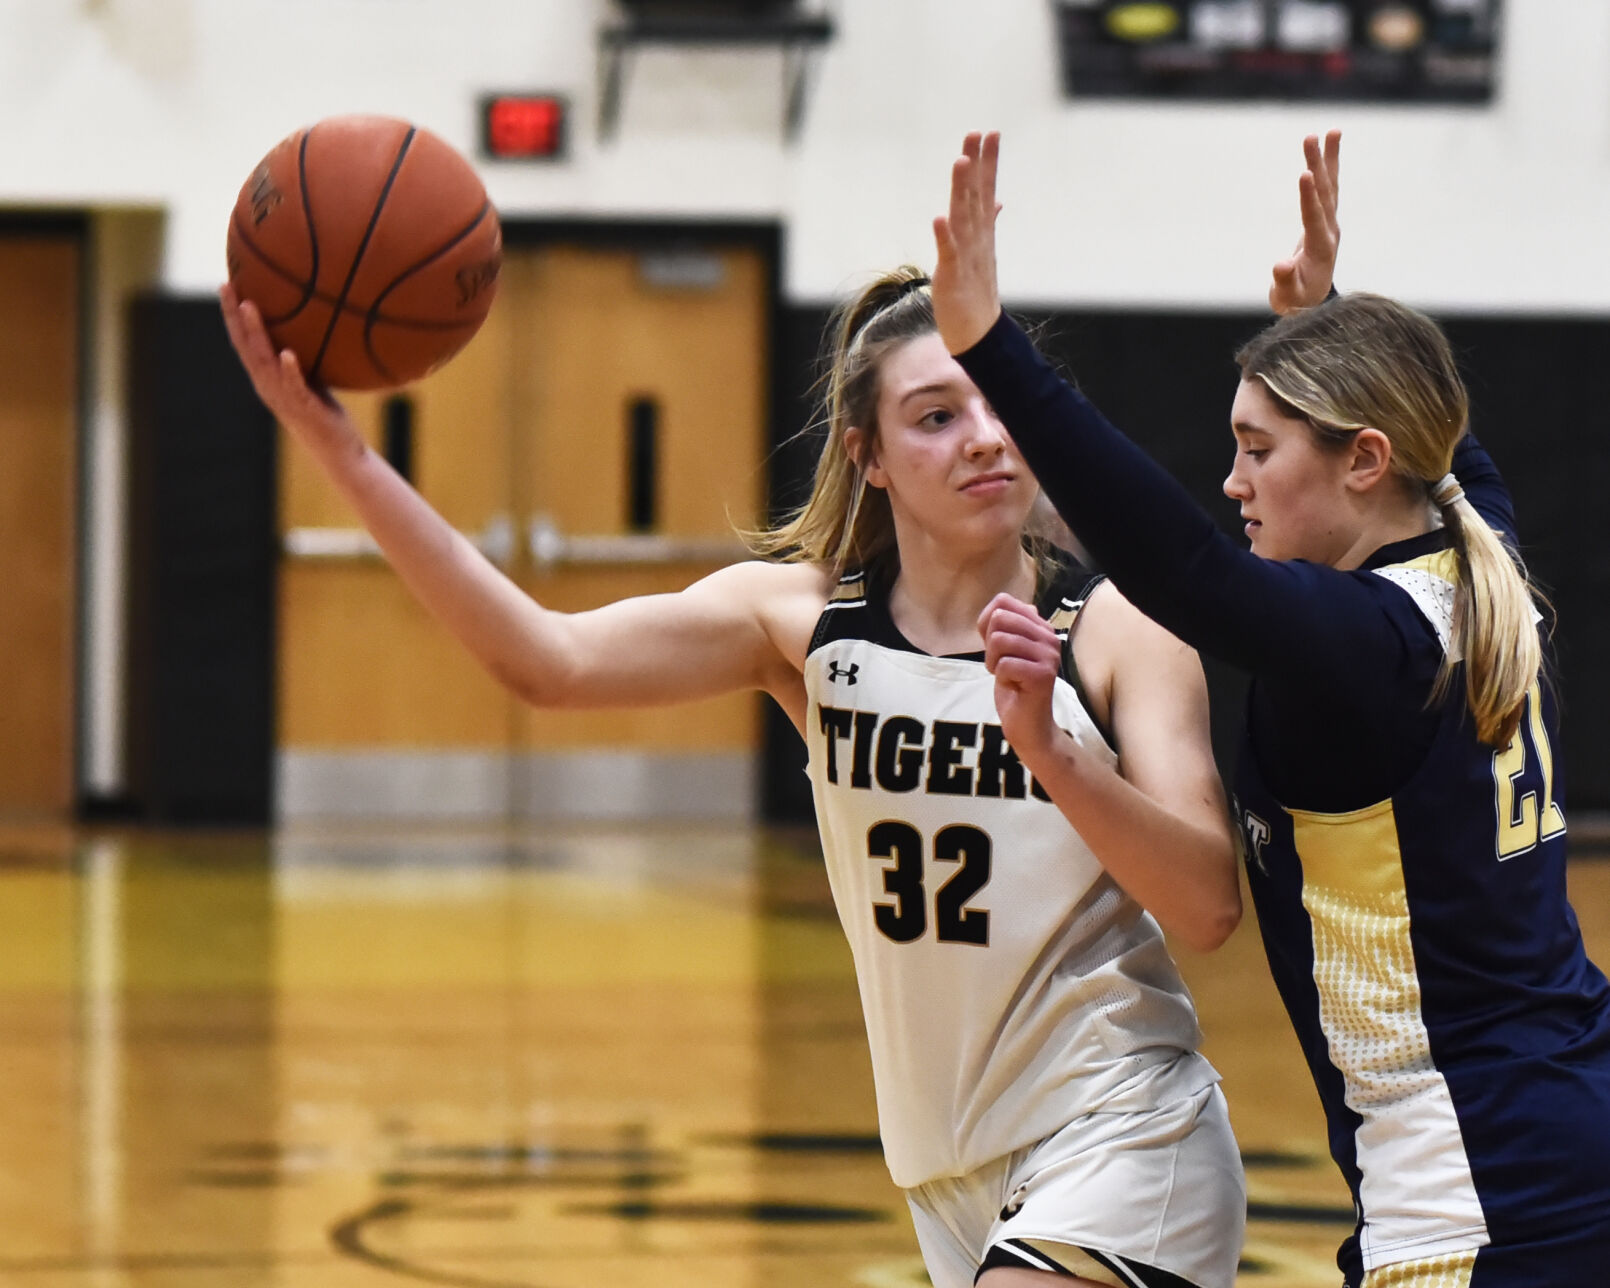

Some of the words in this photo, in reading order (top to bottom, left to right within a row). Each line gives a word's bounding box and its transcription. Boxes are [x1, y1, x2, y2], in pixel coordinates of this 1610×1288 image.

[817, 702, 1055, 803] TIGER
[1492, 677, 1567, 862] 21
[867, 819, 993, 946] 32
